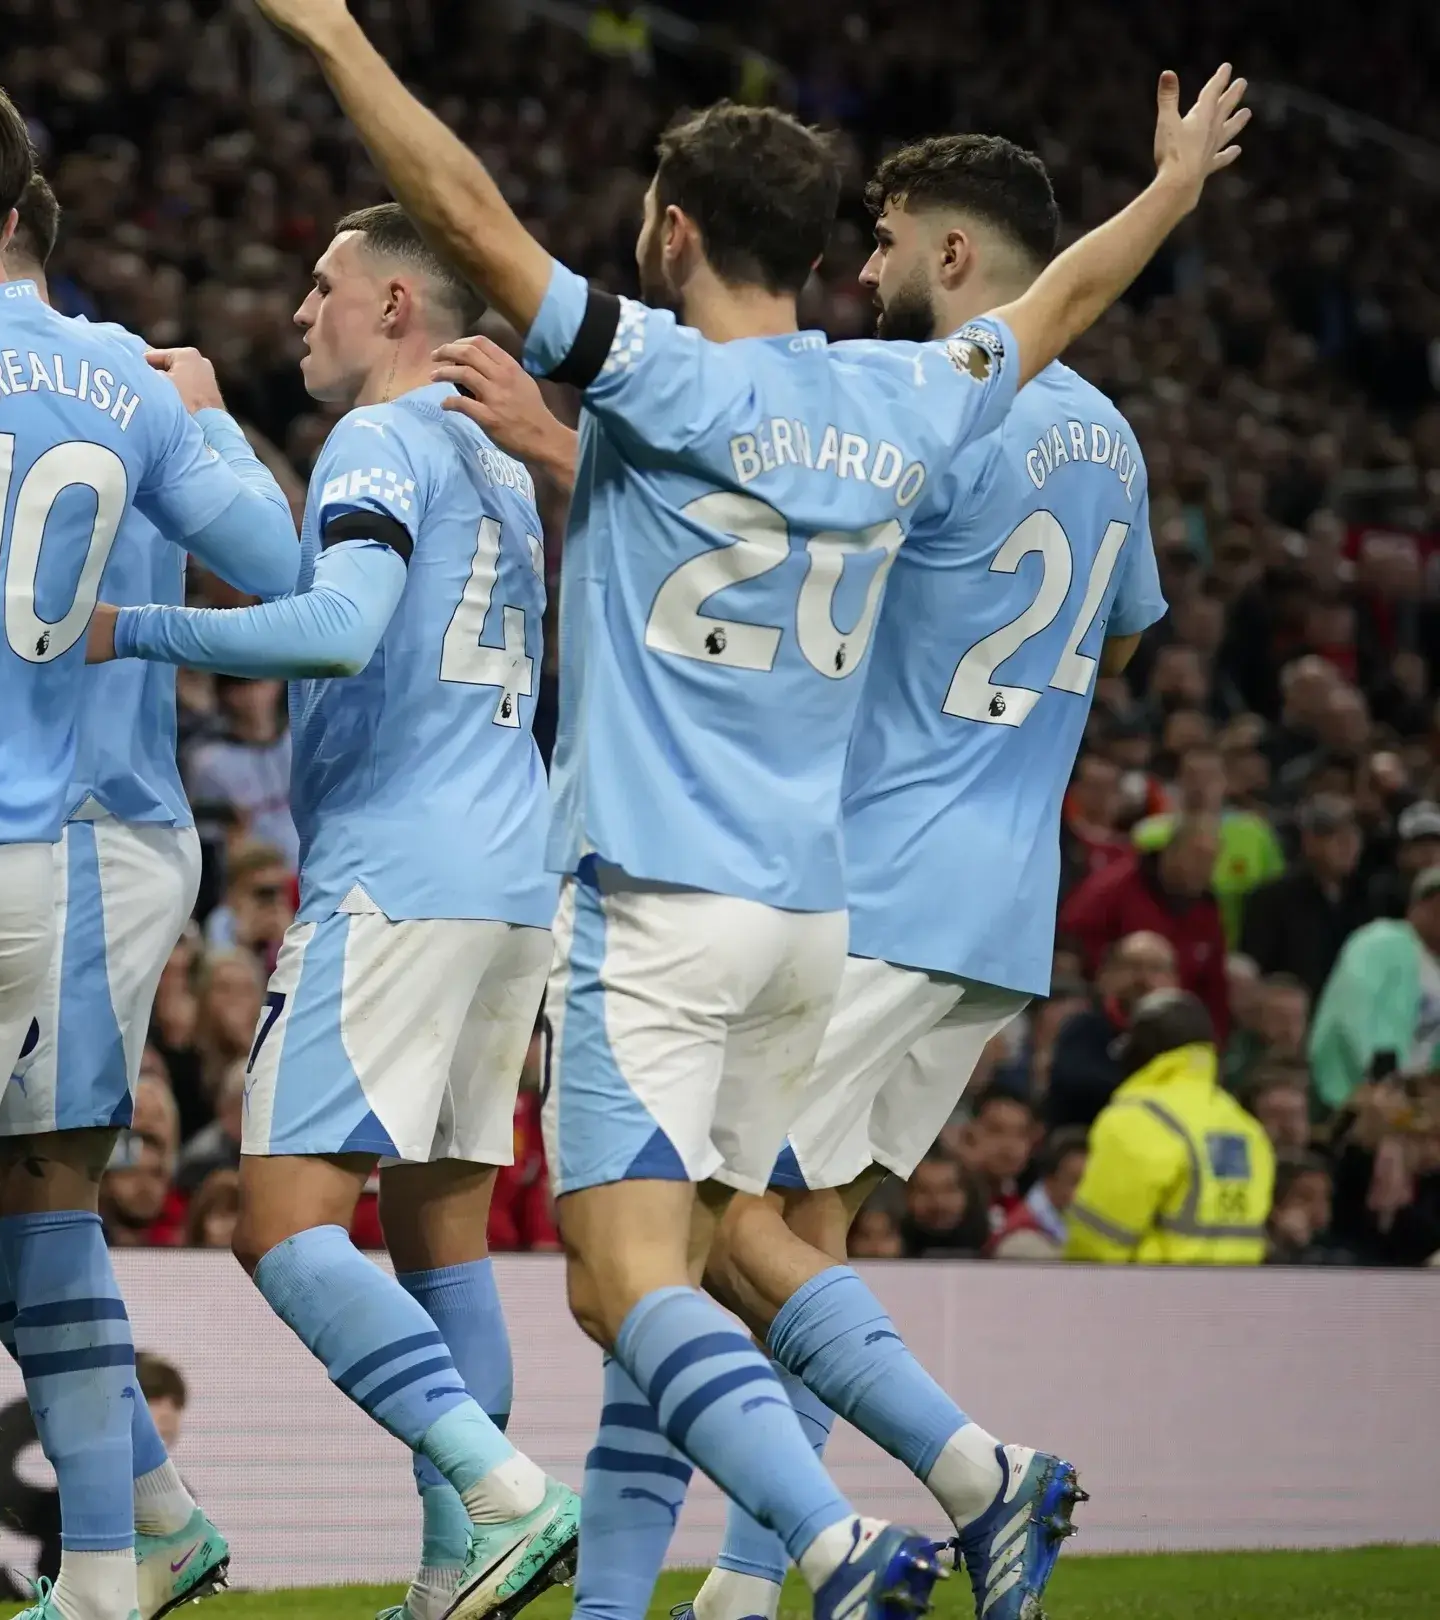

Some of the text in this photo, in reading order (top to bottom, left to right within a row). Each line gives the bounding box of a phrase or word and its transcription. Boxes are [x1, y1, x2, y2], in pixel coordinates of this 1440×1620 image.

[728, 417, 926, 507] BERNARDO
[1025, 419, 1137, 503] GVARDIOL
[645, 490, 907, 680] 20
